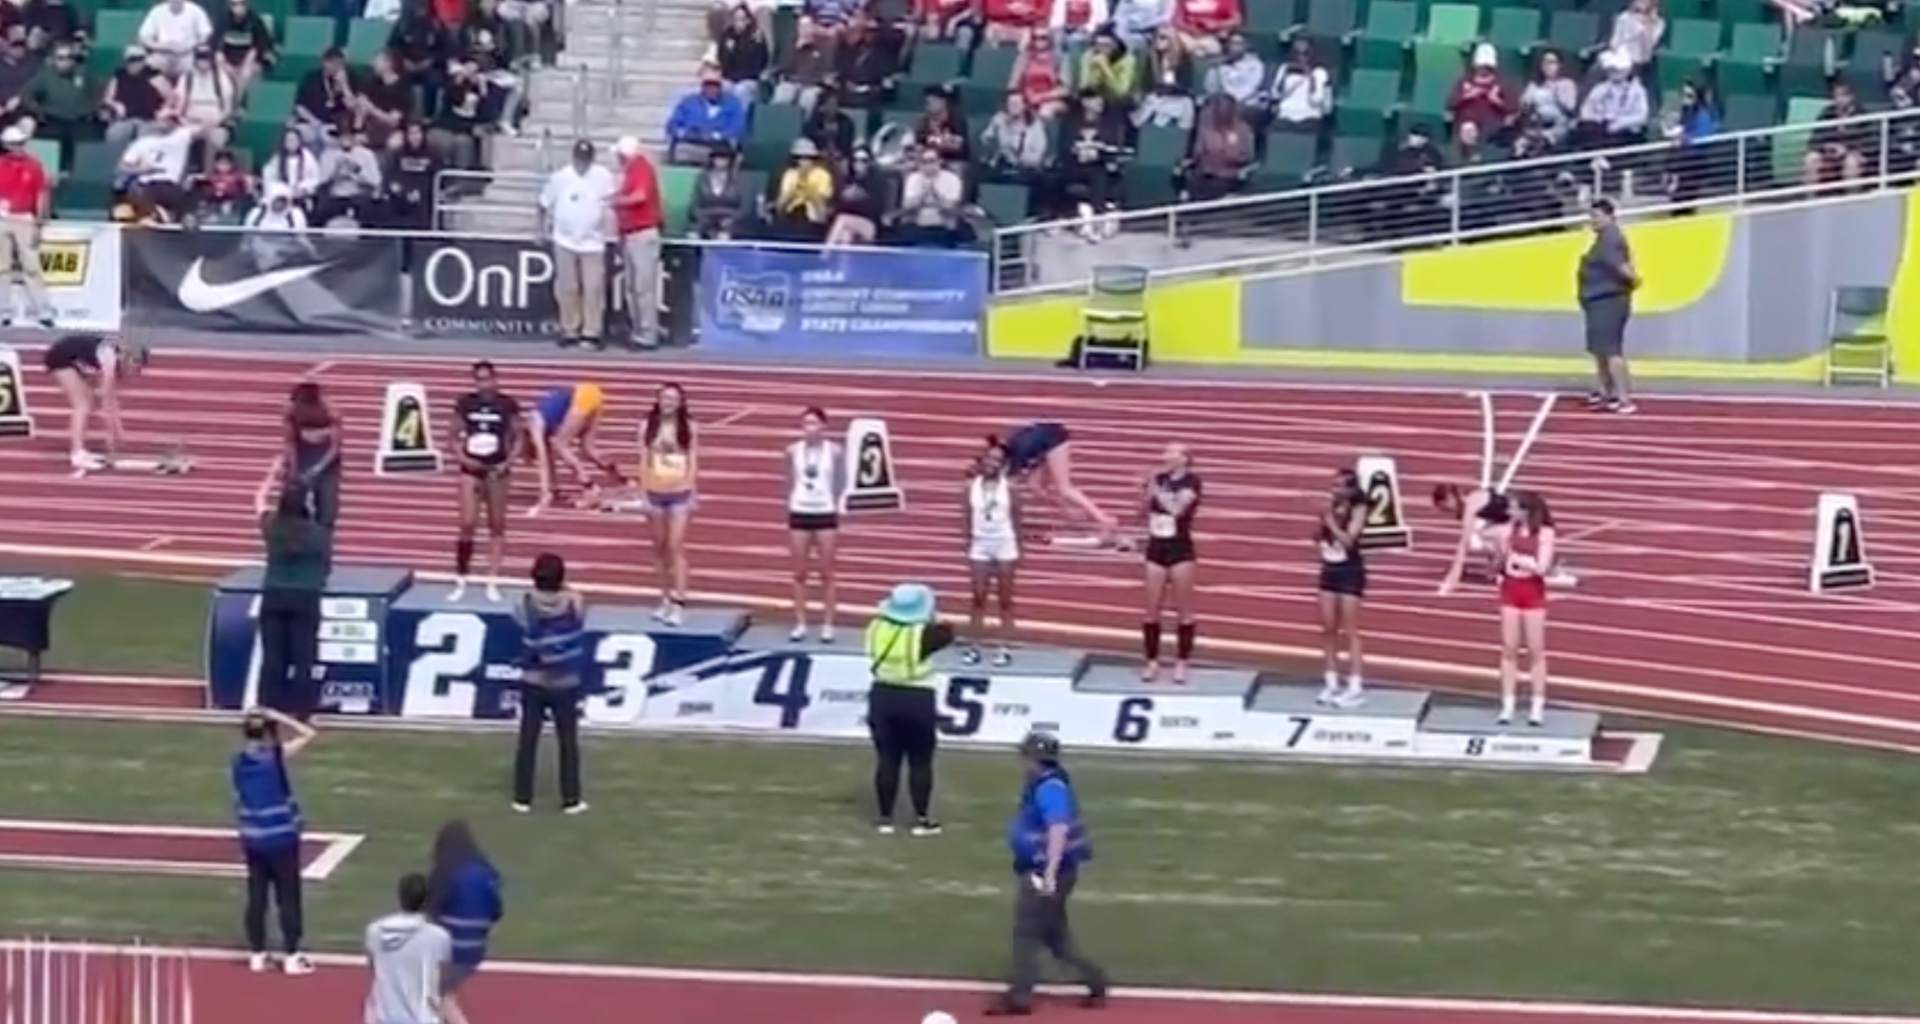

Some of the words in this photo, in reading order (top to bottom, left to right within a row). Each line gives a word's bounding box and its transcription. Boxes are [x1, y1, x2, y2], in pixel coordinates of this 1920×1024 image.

[397, 410, 420, 446] 4
[859, 447, 882, 484] 3
[1369, 485, 1392, 525] 2
[1836, 521, 1850, 562] 1
[403, 613, 487, 717] 2
[583, 633, 656, 722] 3
[752, 652, 813, 729] 4
[936, 676, 991, 736] 5
[1113, 698, 1155, 744] 6
[1286, 716, 1313, 748] 7
[1466, 737, 1486, 756] 8
